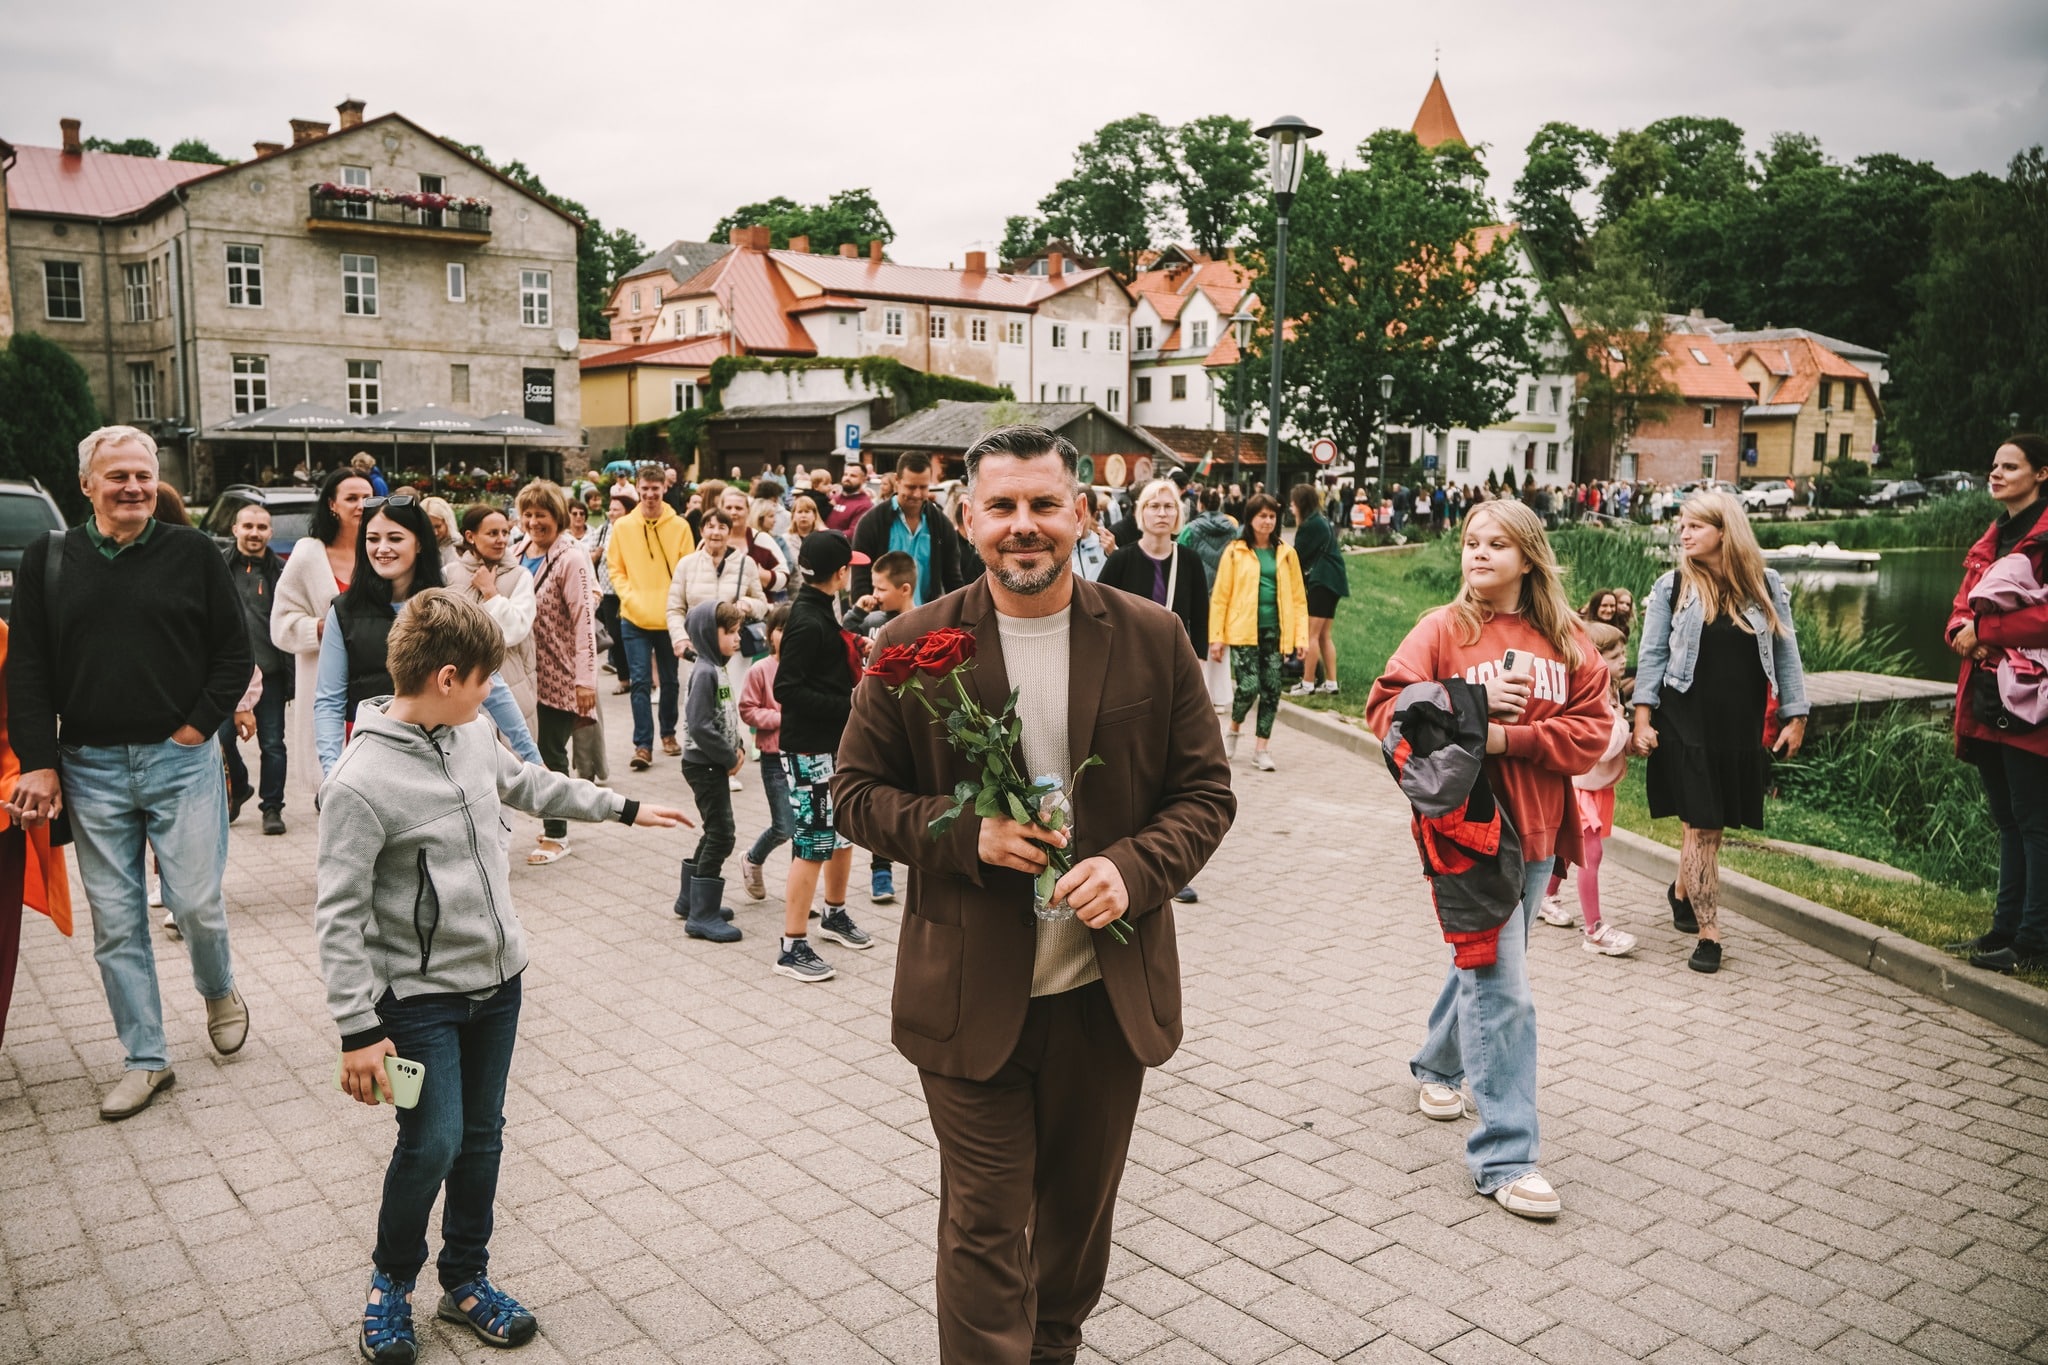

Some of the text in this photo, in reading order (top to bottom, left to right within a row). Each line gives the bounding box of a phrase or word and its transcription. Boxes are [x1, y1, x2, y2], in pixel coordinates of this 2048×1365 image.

[525, 383, 552, 394] Jazz
[525, 394, 552, 402] Coffee
[849, 427, 858, 446] P
